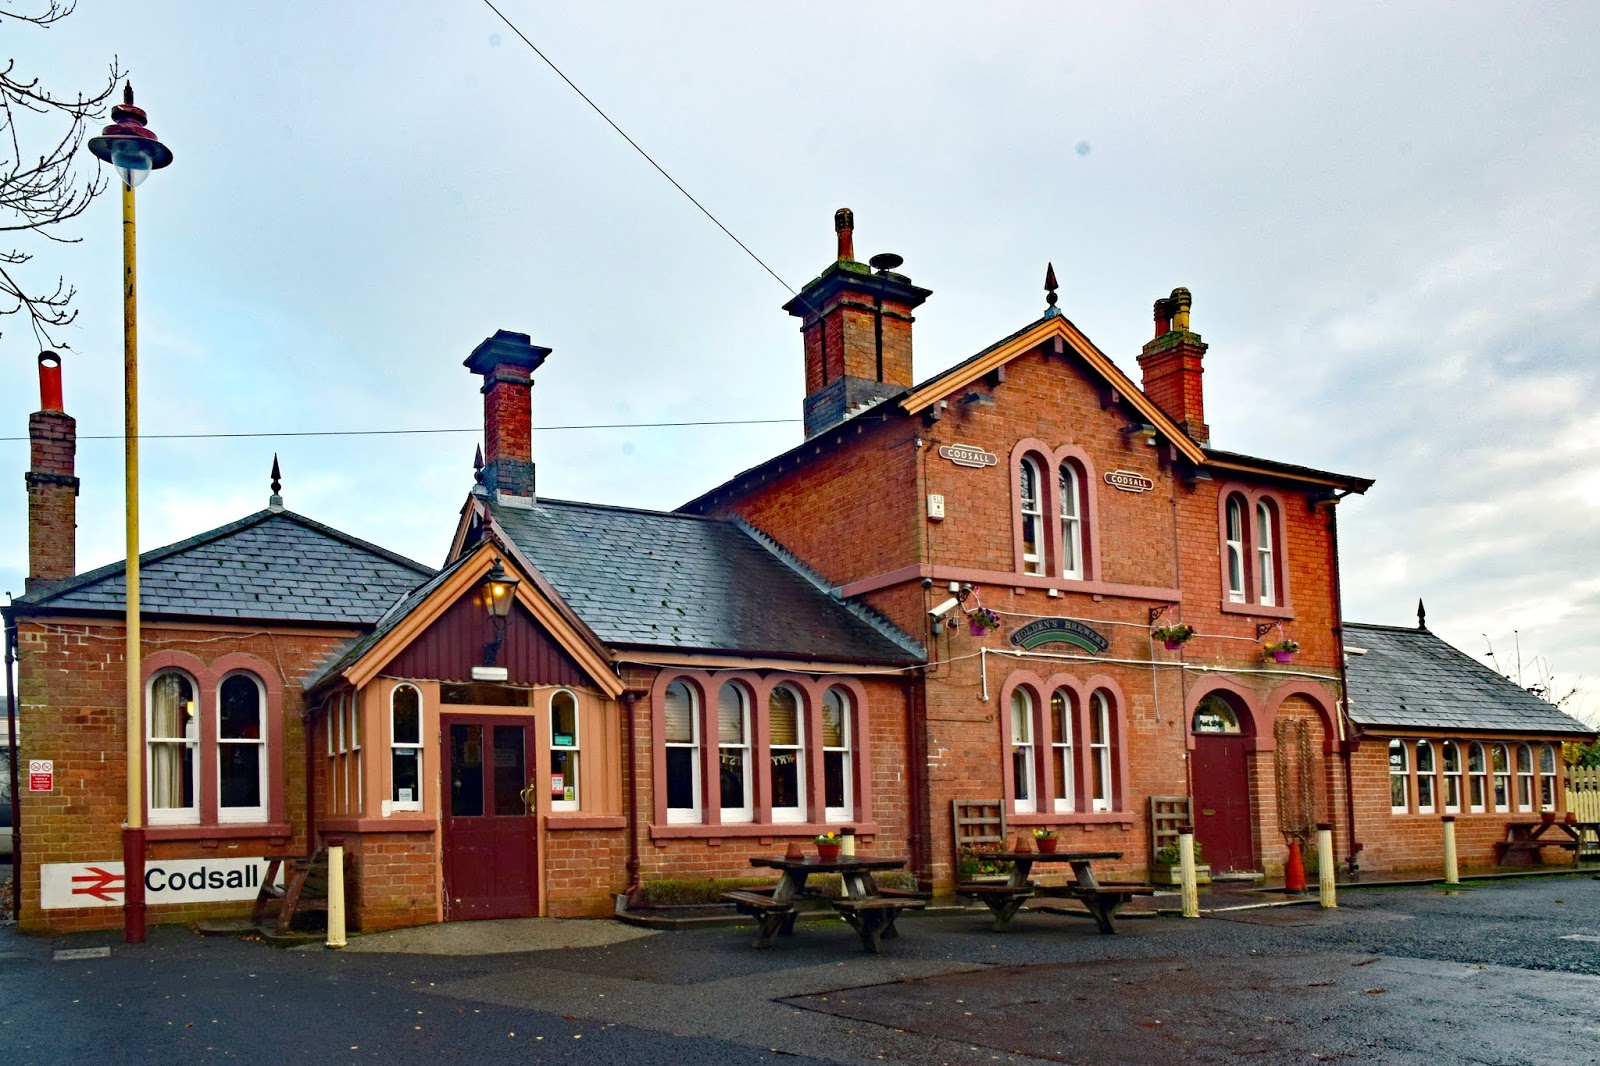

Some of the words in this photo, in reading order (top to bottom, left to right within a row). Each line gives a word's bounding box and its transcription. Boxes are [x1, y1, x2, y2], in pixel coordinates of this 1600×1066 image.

[948, 450, 989, 463] CODSALL
[1111, 475, 1147, 487] CODSALL
[1015, 621, 1058, 643] HOLDEN'S
[1064, 621, 1107, 647] BREWERY
[145, 864, 258, 892] Codsall
